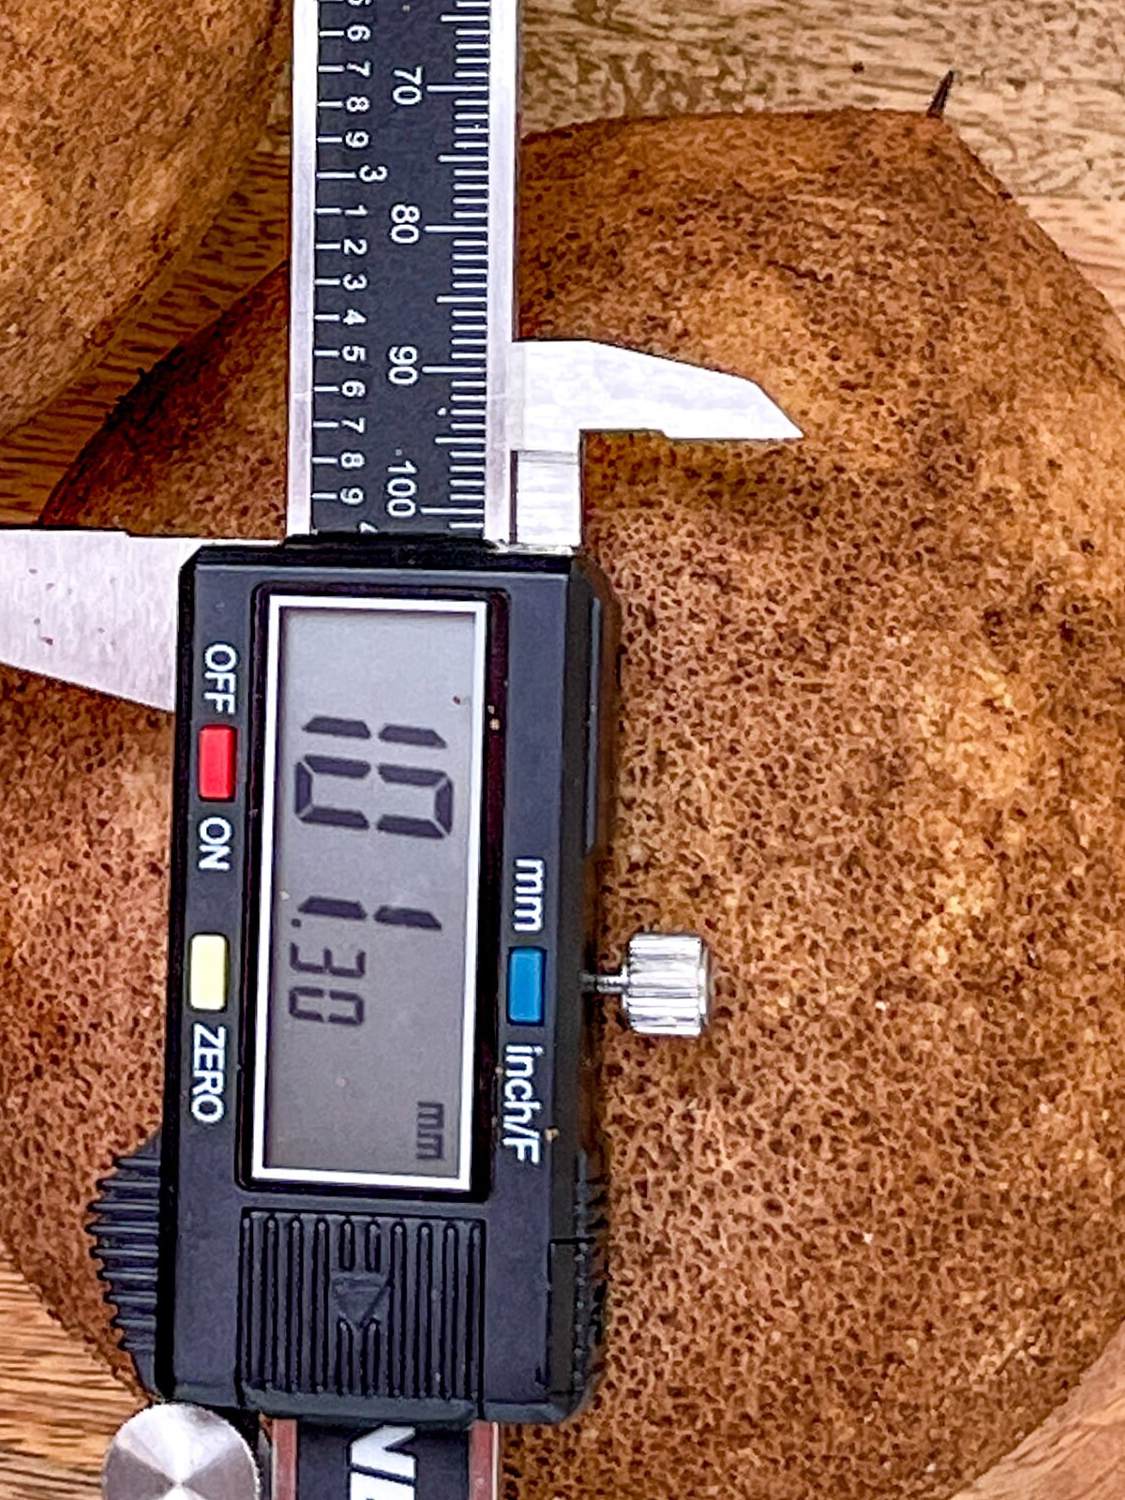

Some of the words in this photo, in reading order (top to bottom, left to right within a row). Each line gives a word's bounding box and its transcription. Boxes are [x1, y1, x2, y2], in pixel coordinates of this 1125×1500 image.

[347, 24, 371, 42] 6
[346, 61, 371, 77] 7
[392, 66, 423, 105] 70
[346, 96, 370, 113] 8
[345, 131, 370, 148] 9
[358, 164, 388, 183] 3
[389, 204, 421, 244] 80
[343, 238, 368, 255] 2
[342, 273, 368, 291] 3
[342, 309, 367, 326] 4
[341, 345, 366, 362] 5
[388, 346, 418, 386] 90
[341, 380, 366, 398] 6
[341, 417, 366, 434] 7
[340, 452, 365, 469] 8
[339, 487, 364, 505] 9
[386, 460, 417, 518] 100
[203, 643, 237, 715] OFF
[198, 816, 233, 871] ON
[513, 858, 544, 932] mm
[190, 1023, 226, 1125] ZERO
[502, 1044, 544, 1164] inch/F
[416, 1101, 445, 1160] mm
